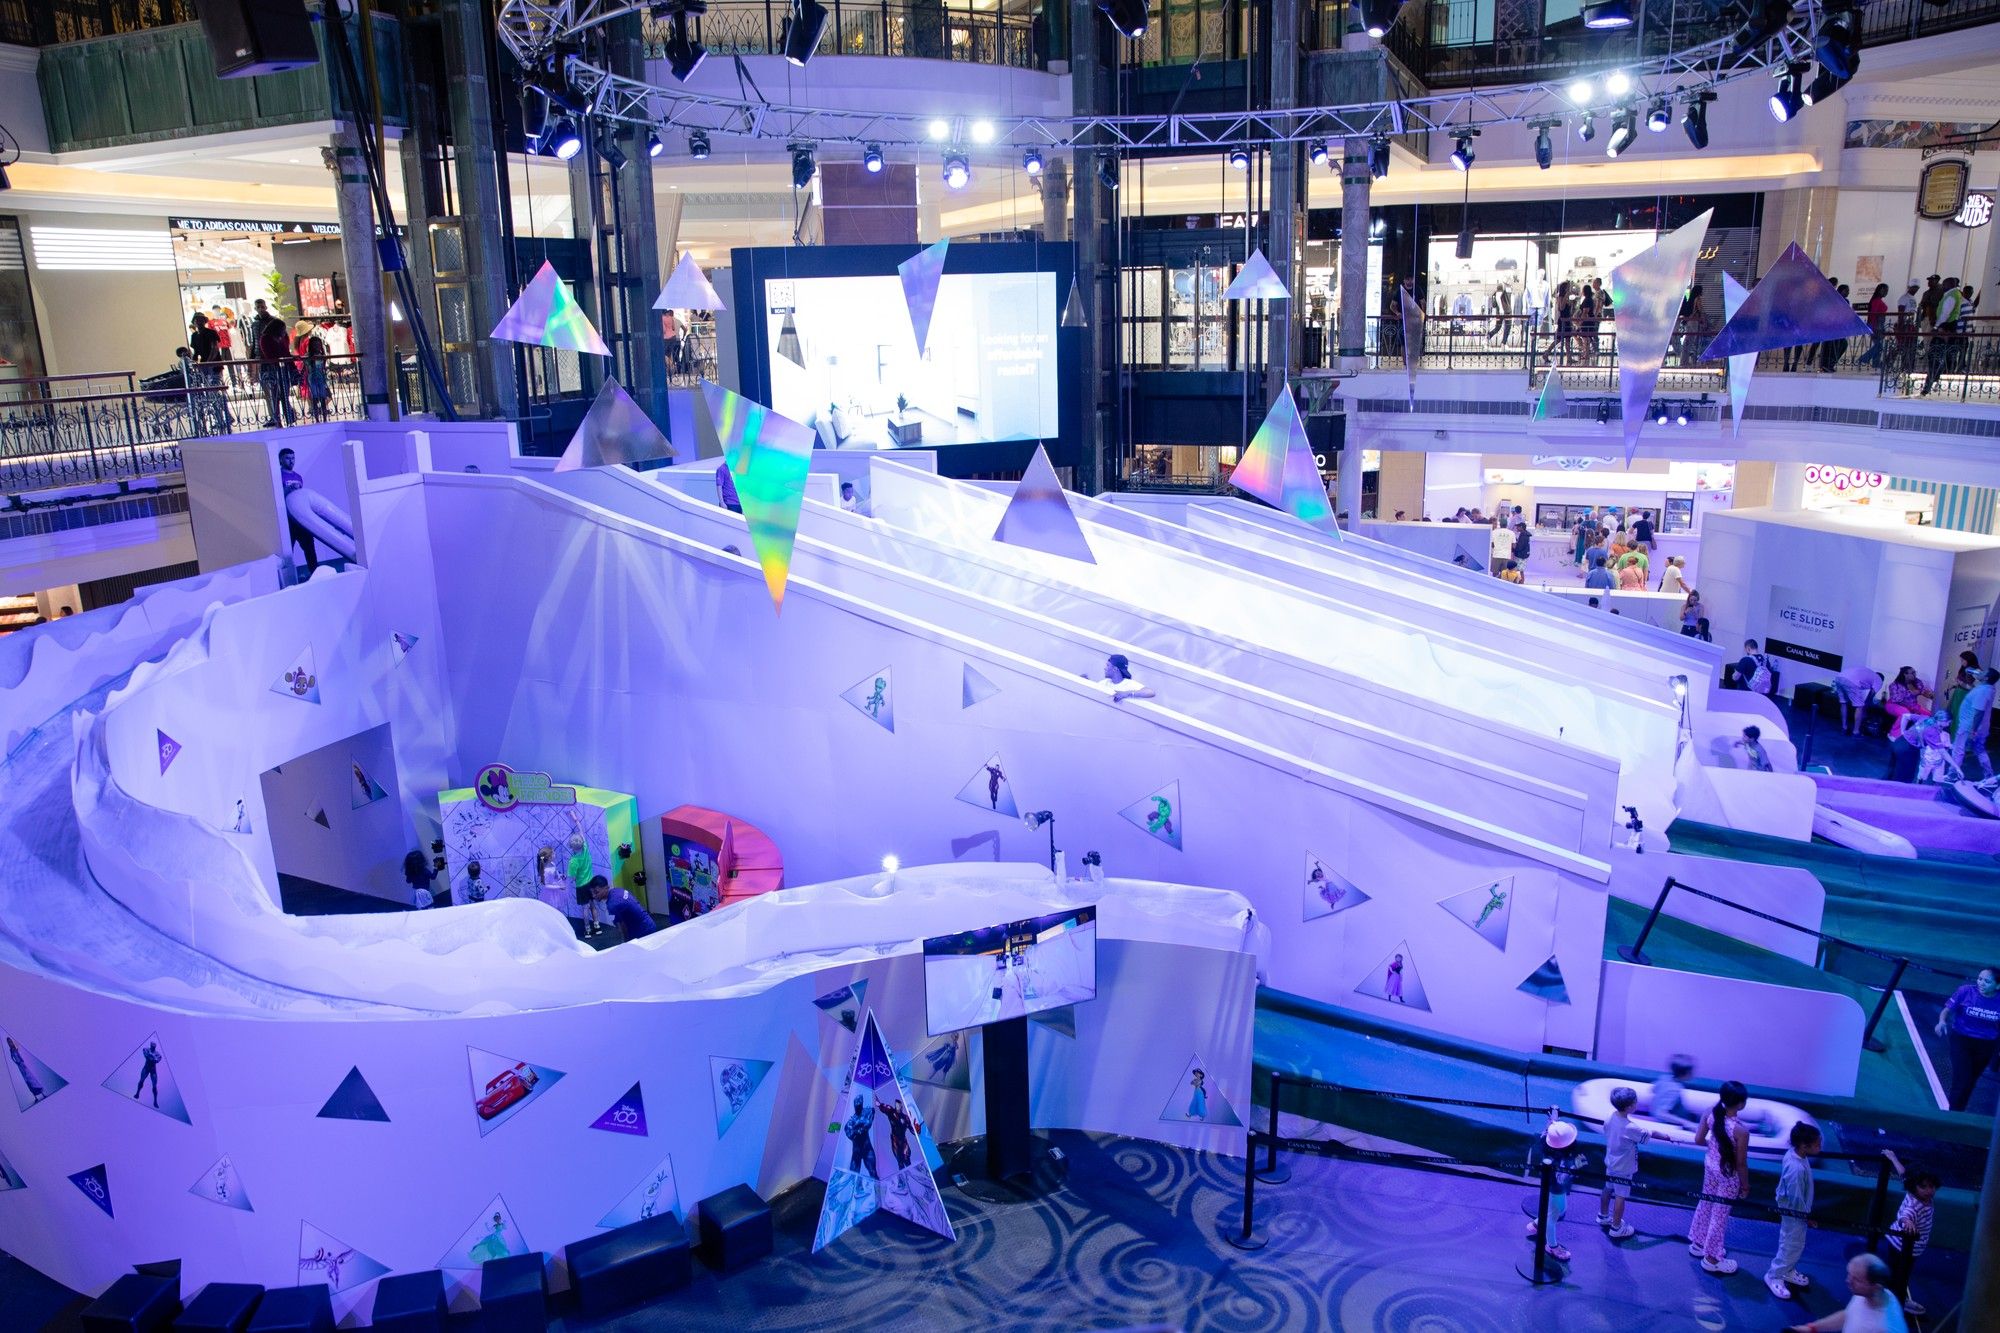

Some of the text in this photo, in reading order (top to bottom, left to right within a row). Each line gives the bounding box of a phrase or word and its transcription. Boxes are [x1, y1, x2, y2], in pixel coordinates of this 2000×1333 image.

[1967, 194, 1988, 208] HEY
[1955, 201, 1994, 226] JUDE
[192, 220, 203, 229] TO
[205, 221, 234, 231] ADIDAS
[234, 223, 261, 232] CANAL
[261, 223, 284, 232] WALK
[1780, 609, 1835, 630] ICE SLIDES
[1791, 623, 1814, 632] INSPIRED
[1954, 631, 1969, 642] ICE
[613, 1110, 638, 1124] 100
